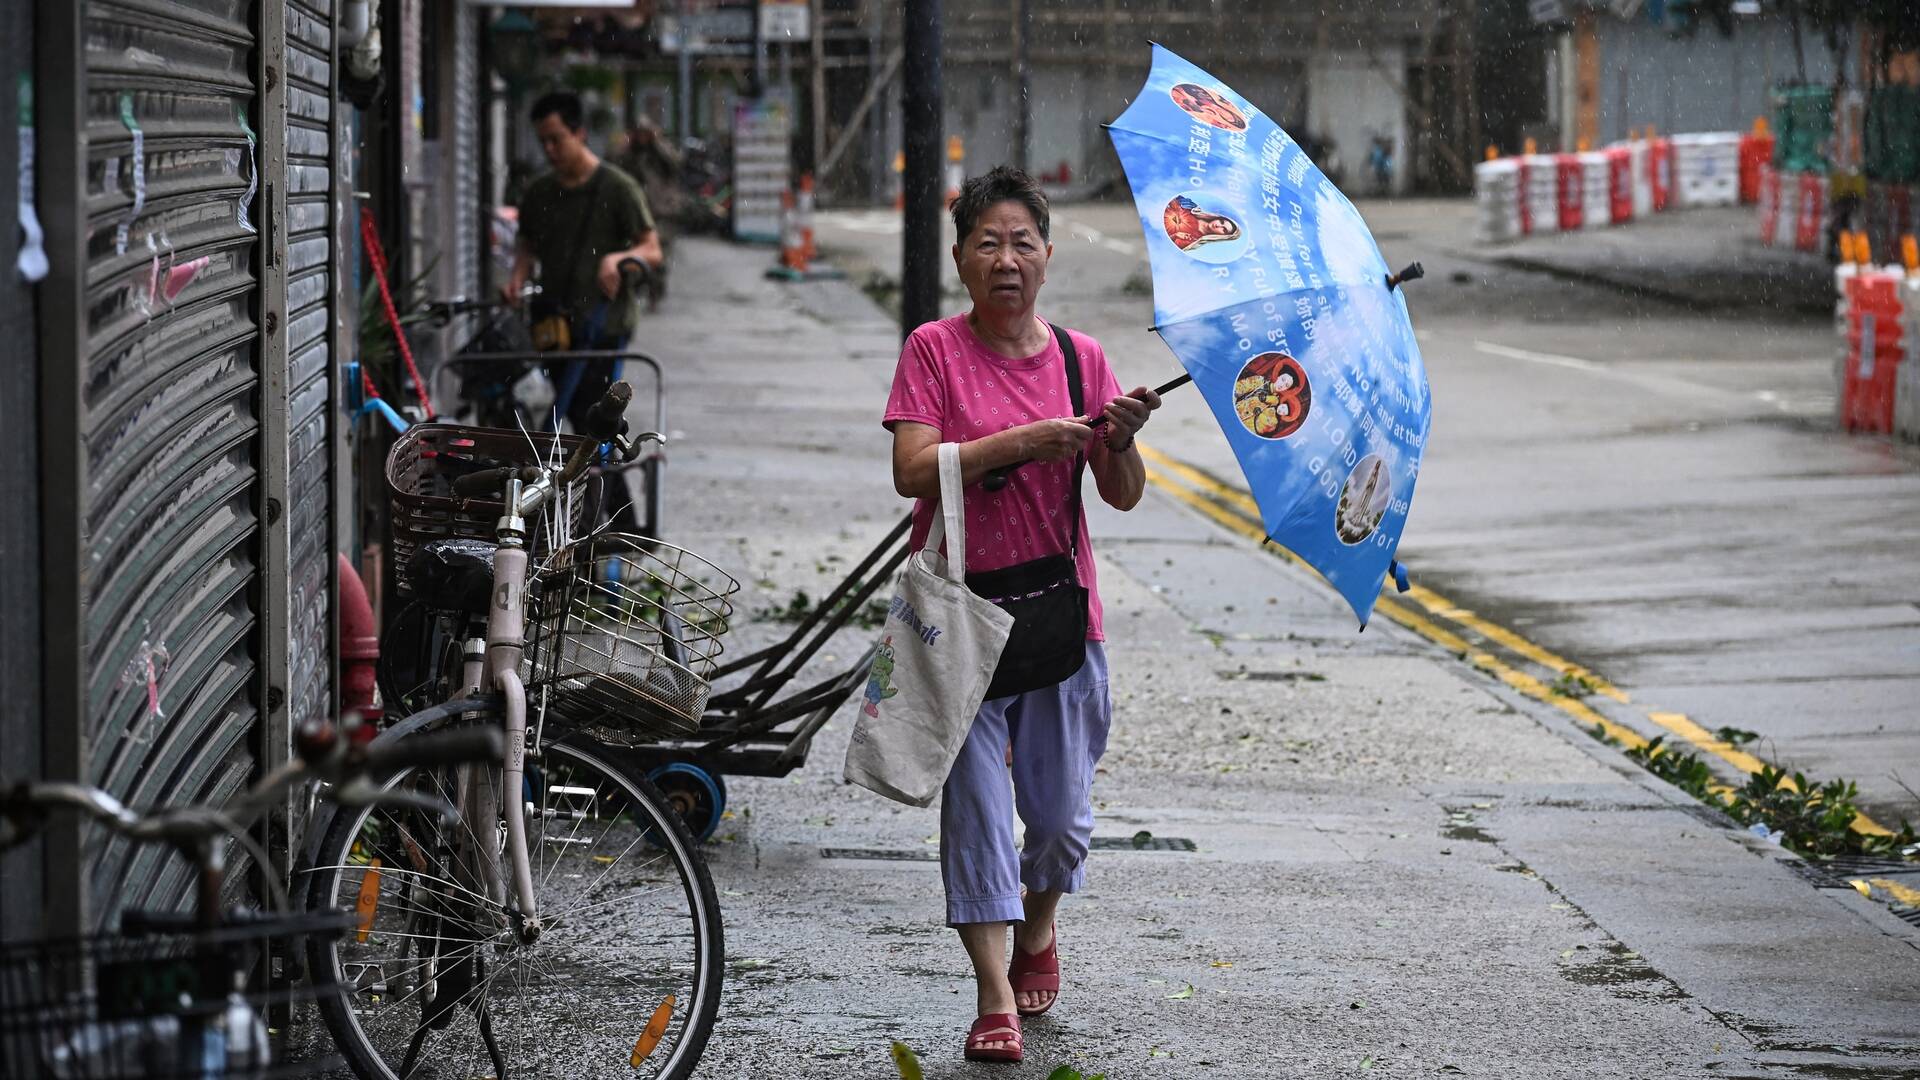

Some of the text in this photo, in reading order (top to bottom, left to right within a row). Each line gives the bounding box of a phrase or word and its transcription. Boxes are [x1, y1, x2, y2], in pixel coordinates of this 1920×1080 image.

[1188, 123, 1212, 157] 利亞
[1263, 301, 1283, 323] of
[1289, 200, 1304, 241] Pray
[1297, 243, 1314, 270] for
[1377, 404, 1394, 431] and
[1393, 423, 1405, 440] at
[1405, 428, 1423, 448] the
[1395, 387, 1411, 414] thy
[1308, 456, 1339, 499] GOD
[1321, 416, 1408, 516] LORD hee
